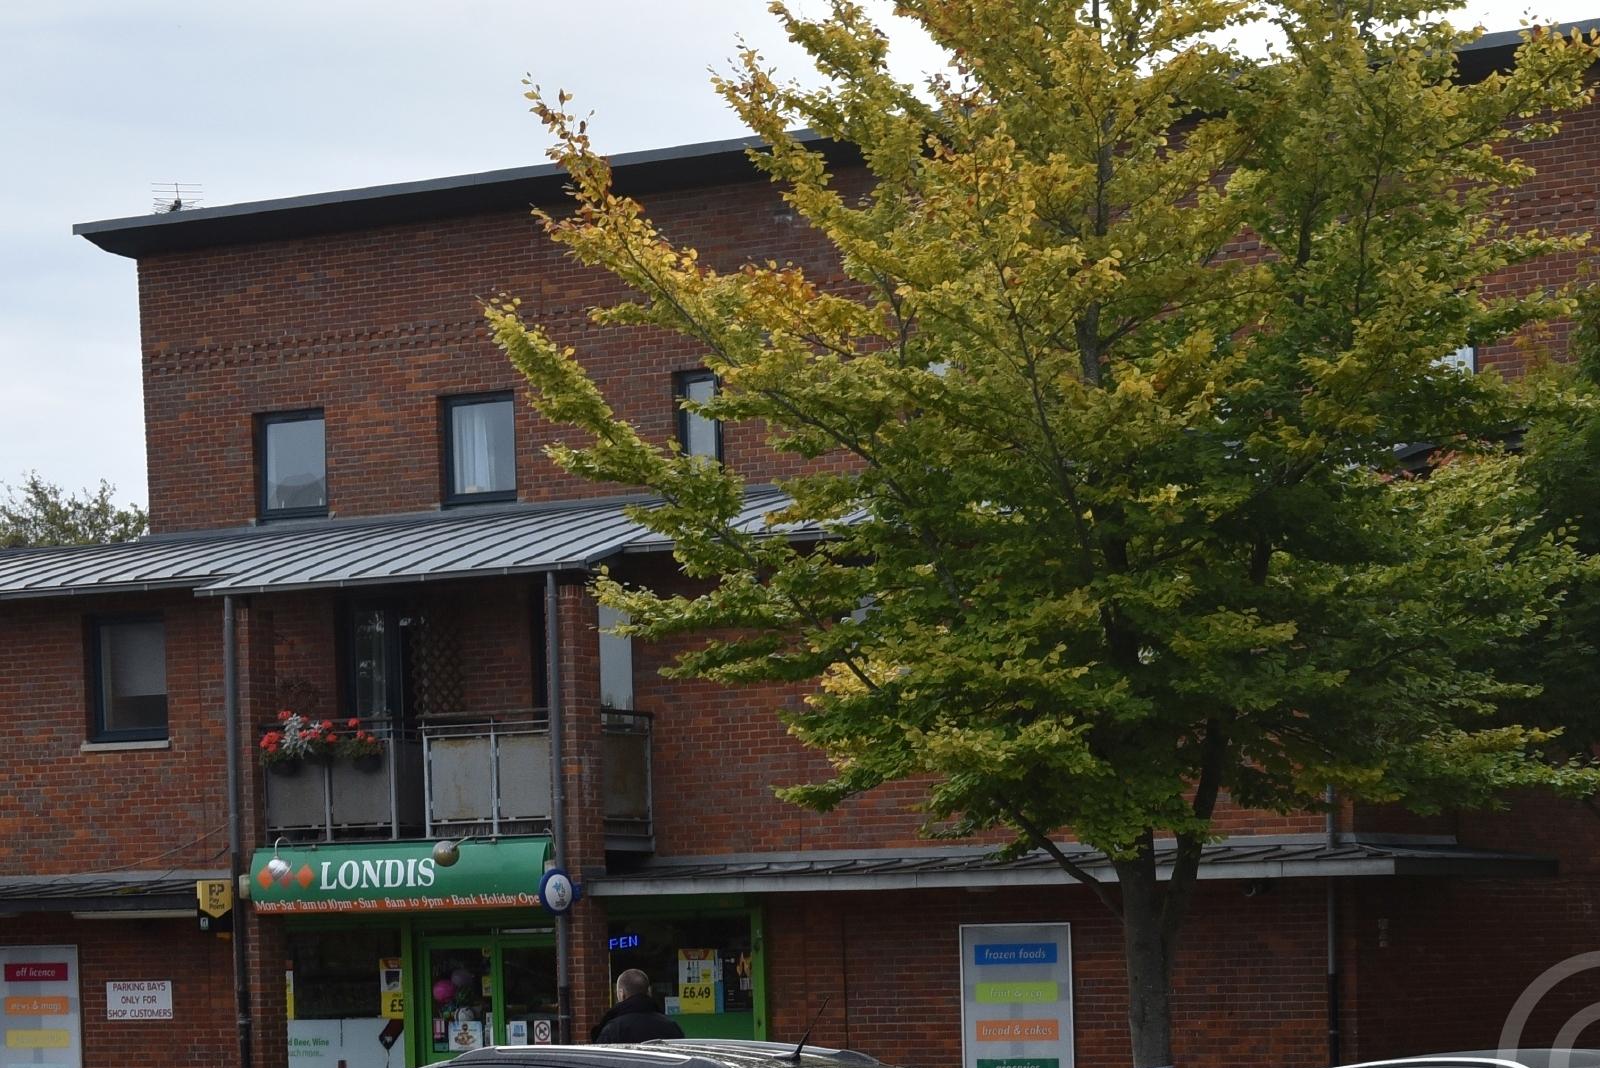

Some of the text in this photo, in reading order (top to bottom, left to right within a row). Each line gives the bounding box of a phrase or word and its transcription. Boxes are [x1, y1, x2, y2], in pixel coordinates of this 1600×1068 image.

[320, 857, 436, 890] LONDIS
[255, 899, 296, 911] Mon-Sat
[358, 897, 377, 909] Sun
[384, 896, 406, 908] 8am
[409, 897, 419, 907] to
[422, 896, 442, 909] 9pm
[451, 894, 477, 906] Bank
[480, 893, 517, 905] Holiday
[518, 892, 541, 905] Ope
[609, 935, 638, 950] PEN
[985, 947, 1046, 961] frozen foods
[112, 982, 166, 991] PARKING BAYS
[682, 986, 711, 999] £6.49
[120, 995, 157, 1004] ONLY FOR
[107, 1008, 172, 1018] SHOP CUSTOMERS
